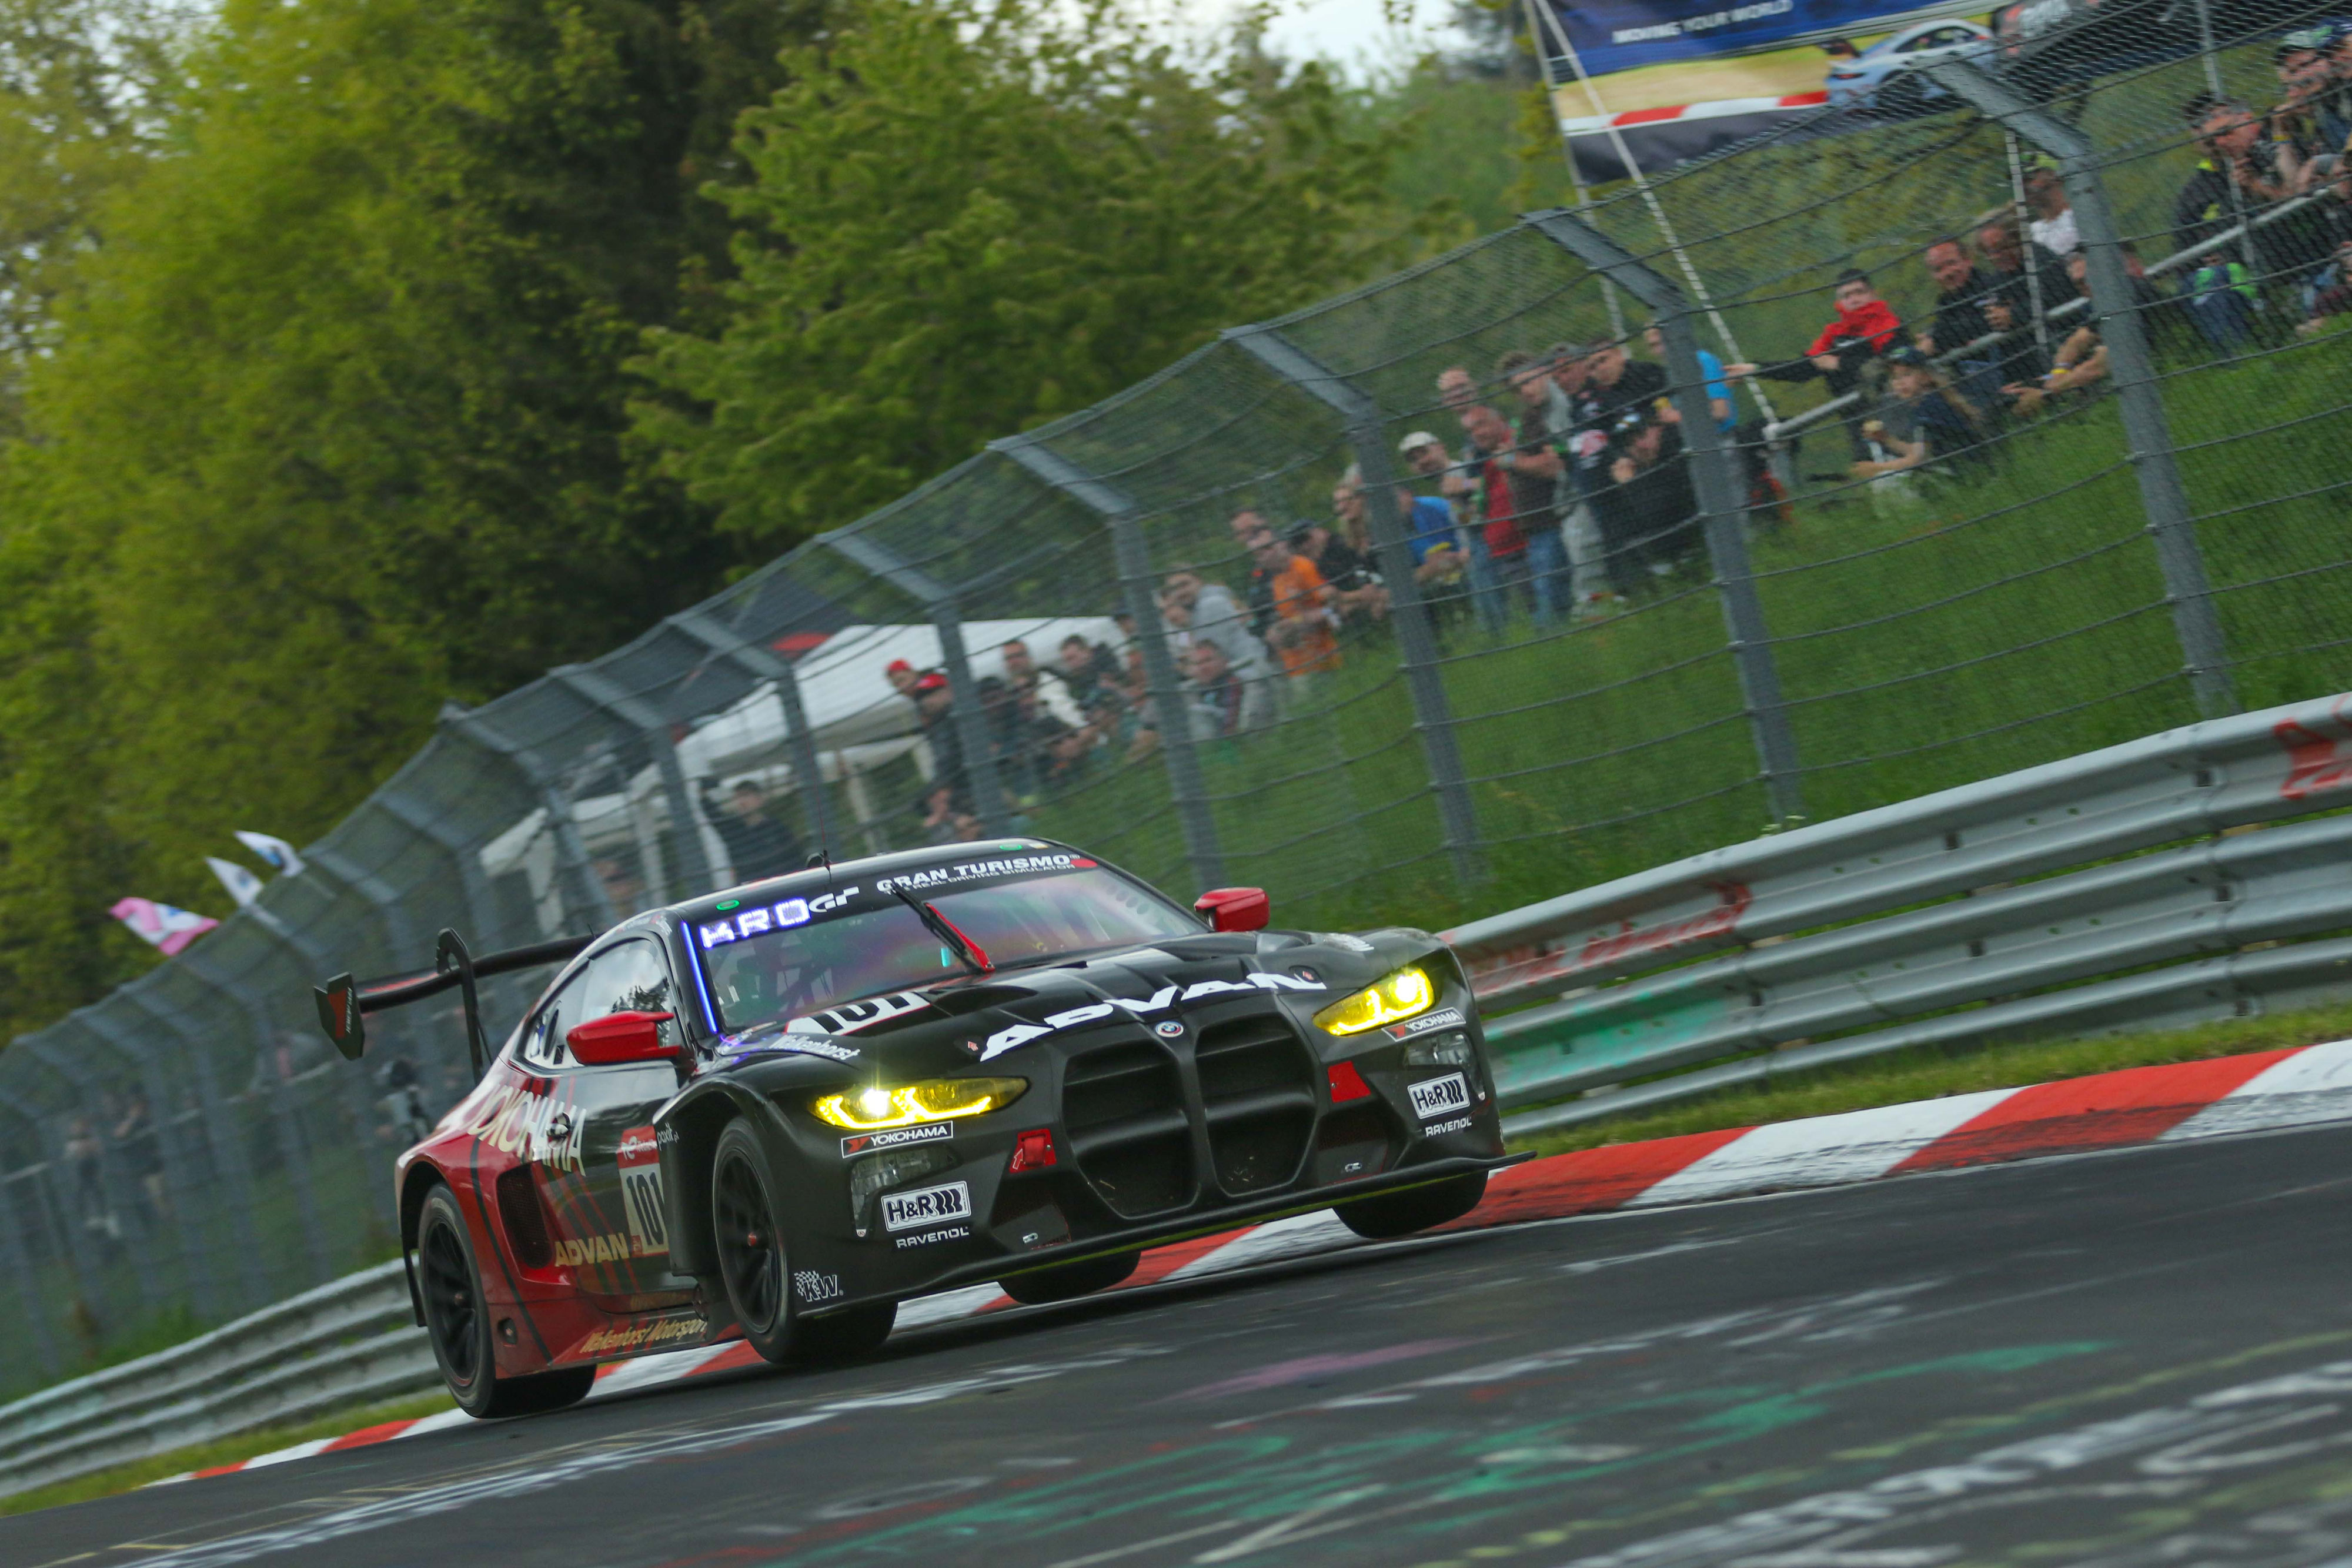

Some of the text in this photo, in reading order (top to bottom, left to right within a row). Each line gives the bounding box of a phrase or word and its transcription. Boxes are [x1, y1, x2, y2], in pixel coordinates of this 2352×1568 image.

[876, 854, 1071, 892] GRAN TURISMO
[947, 870, 1000, 883] DRIVING
[1002, 862, 1075, 875] SIMULATOR
[980, 972, 1327, 1062] ADVAN
[1405, 1010, 1461, 1032] YOKOHAMA
[1413, 1084, 1449, 1111] H&R
[870, 1125, 948, 1147] YOKOHAMA
[1425, 1117, 1472, 1138] RAVENOL
[886, 1194, 937, 1223] H&R
[554, 1232, 630, 1268] ADVAN
[896, 1226, 970, 1249] RAVENOL
[803, 1274, 838, 1302] KW
